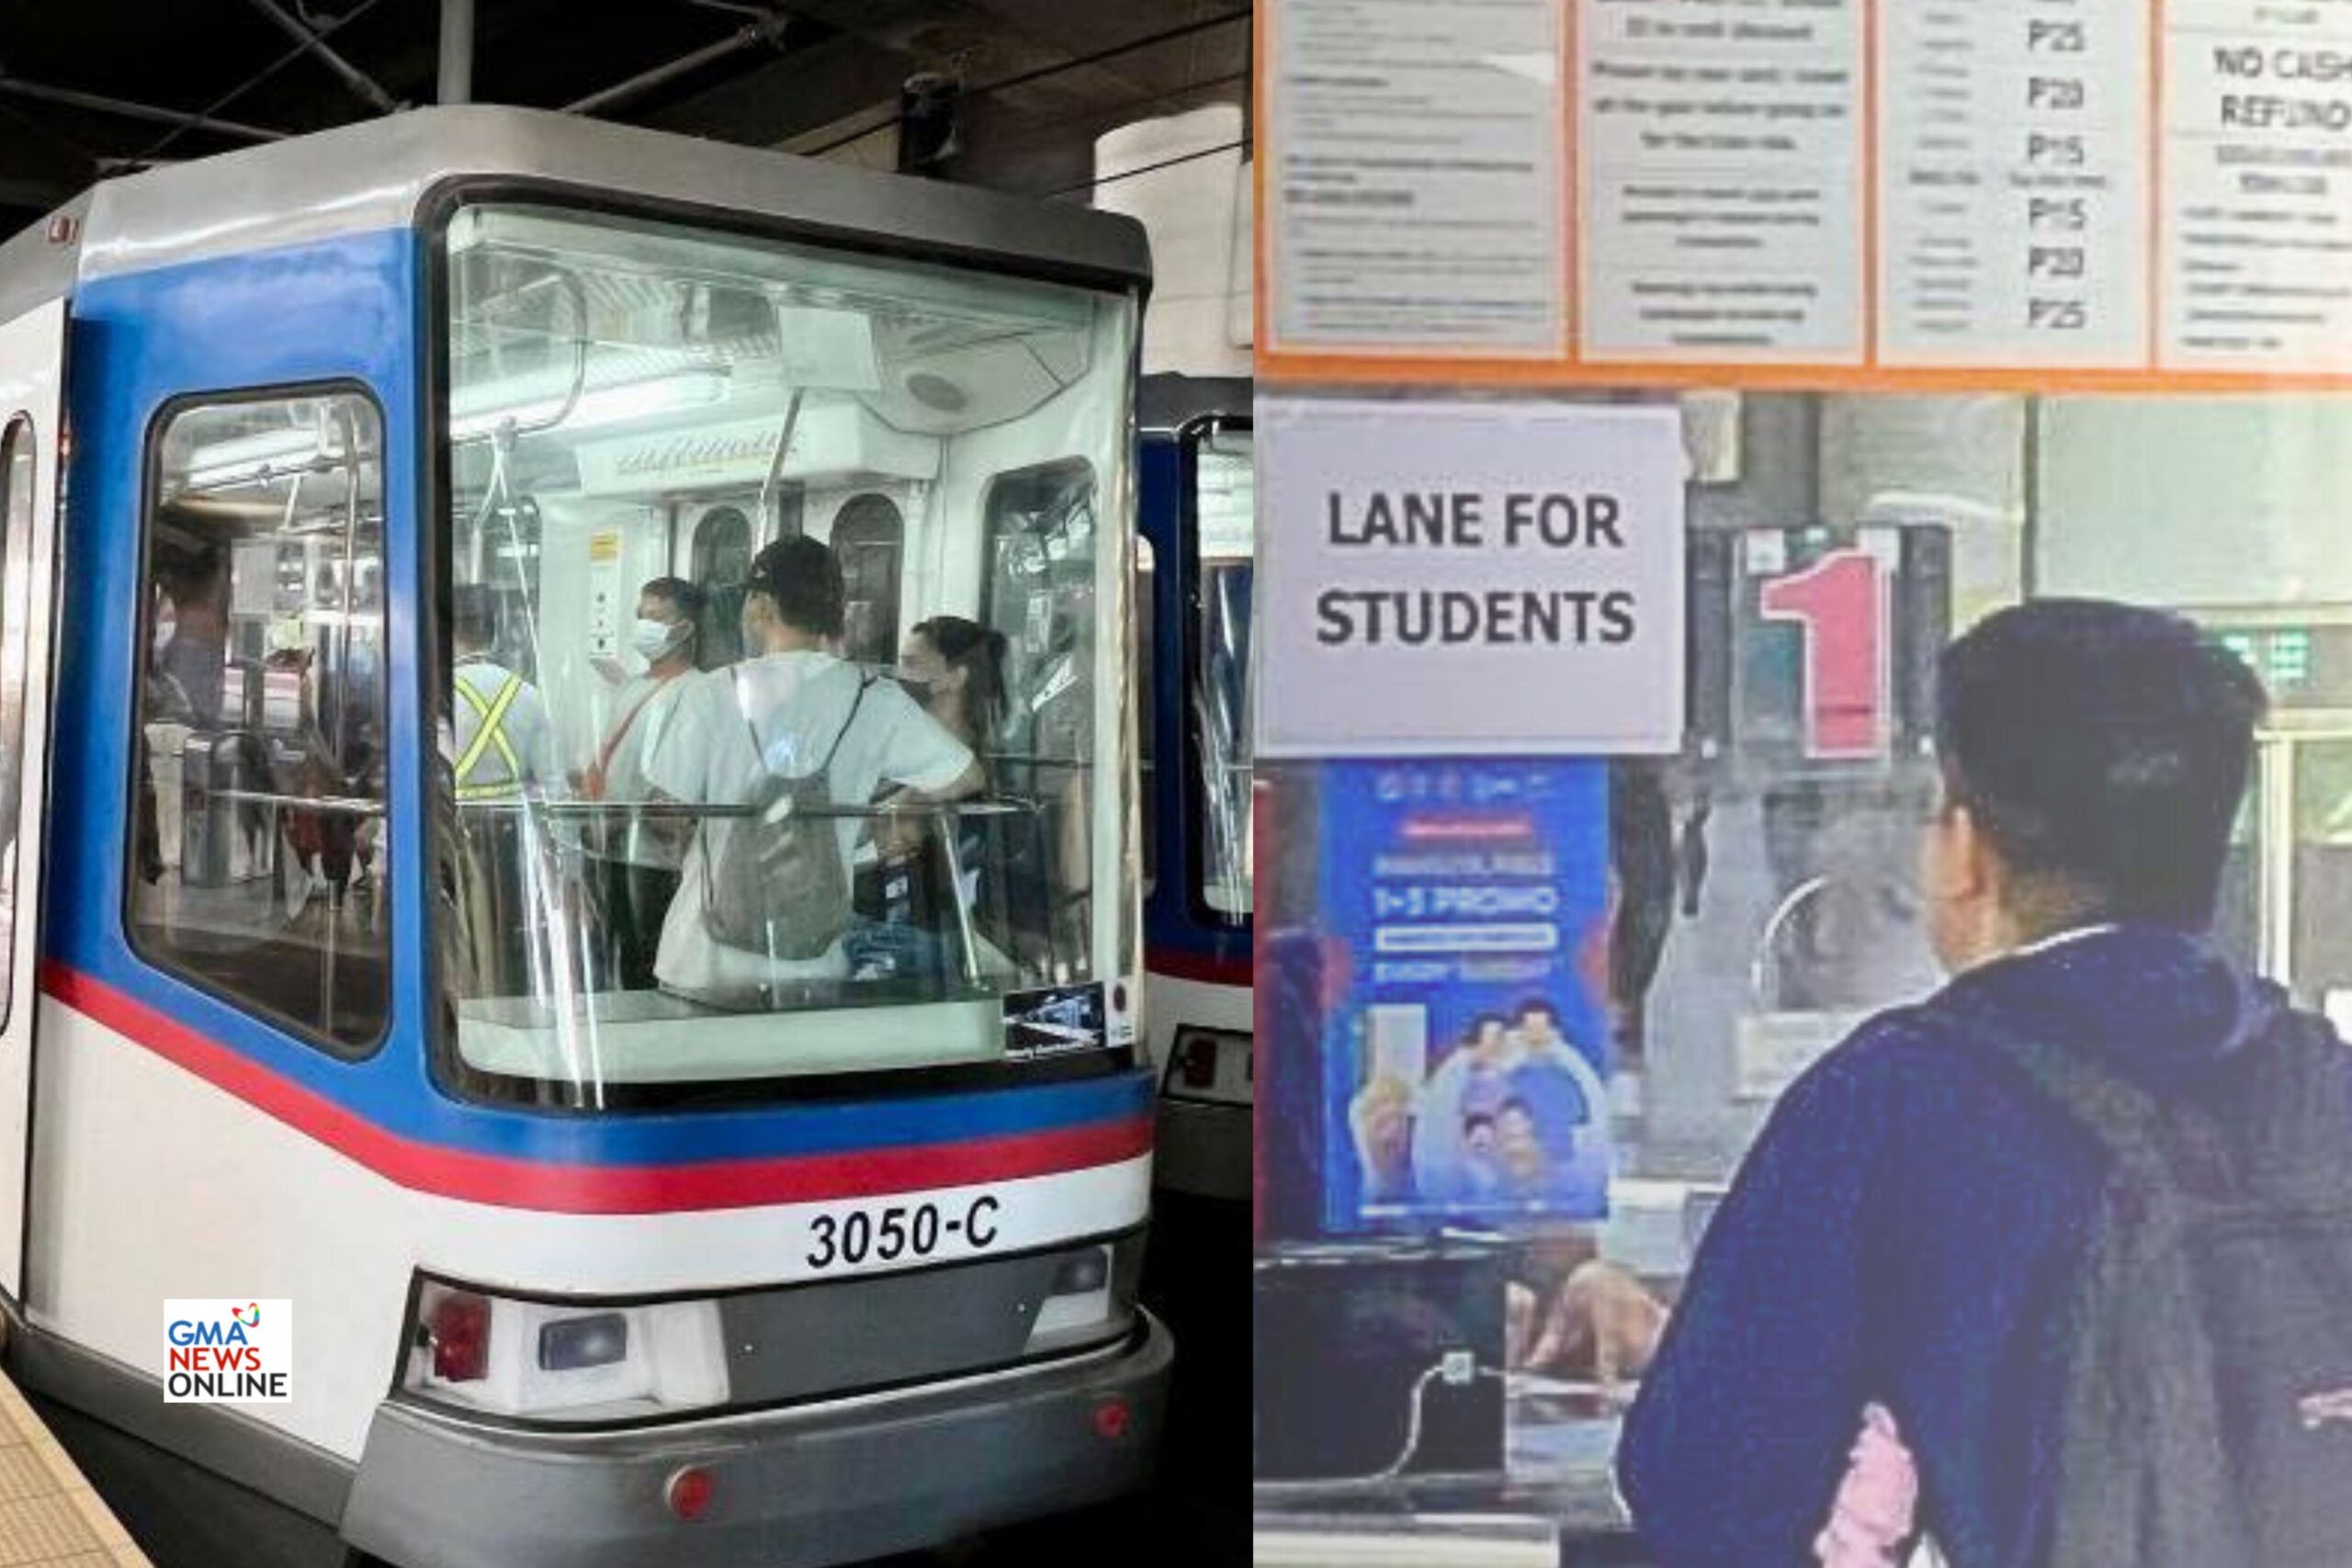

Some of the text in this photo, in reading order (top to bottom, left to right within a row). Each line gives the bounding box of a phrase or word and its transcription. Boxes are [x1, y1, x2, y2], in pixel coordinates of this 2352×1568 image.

[2212, 46, 2264, 79] NO
[1328, 491, 1625, 548] LANE FOR
[1316, 588, 1635, 647] STUDENTS
[1759, 548, 1892, 759] 1
[806, 1195, 1000, 1269] 3050-C
